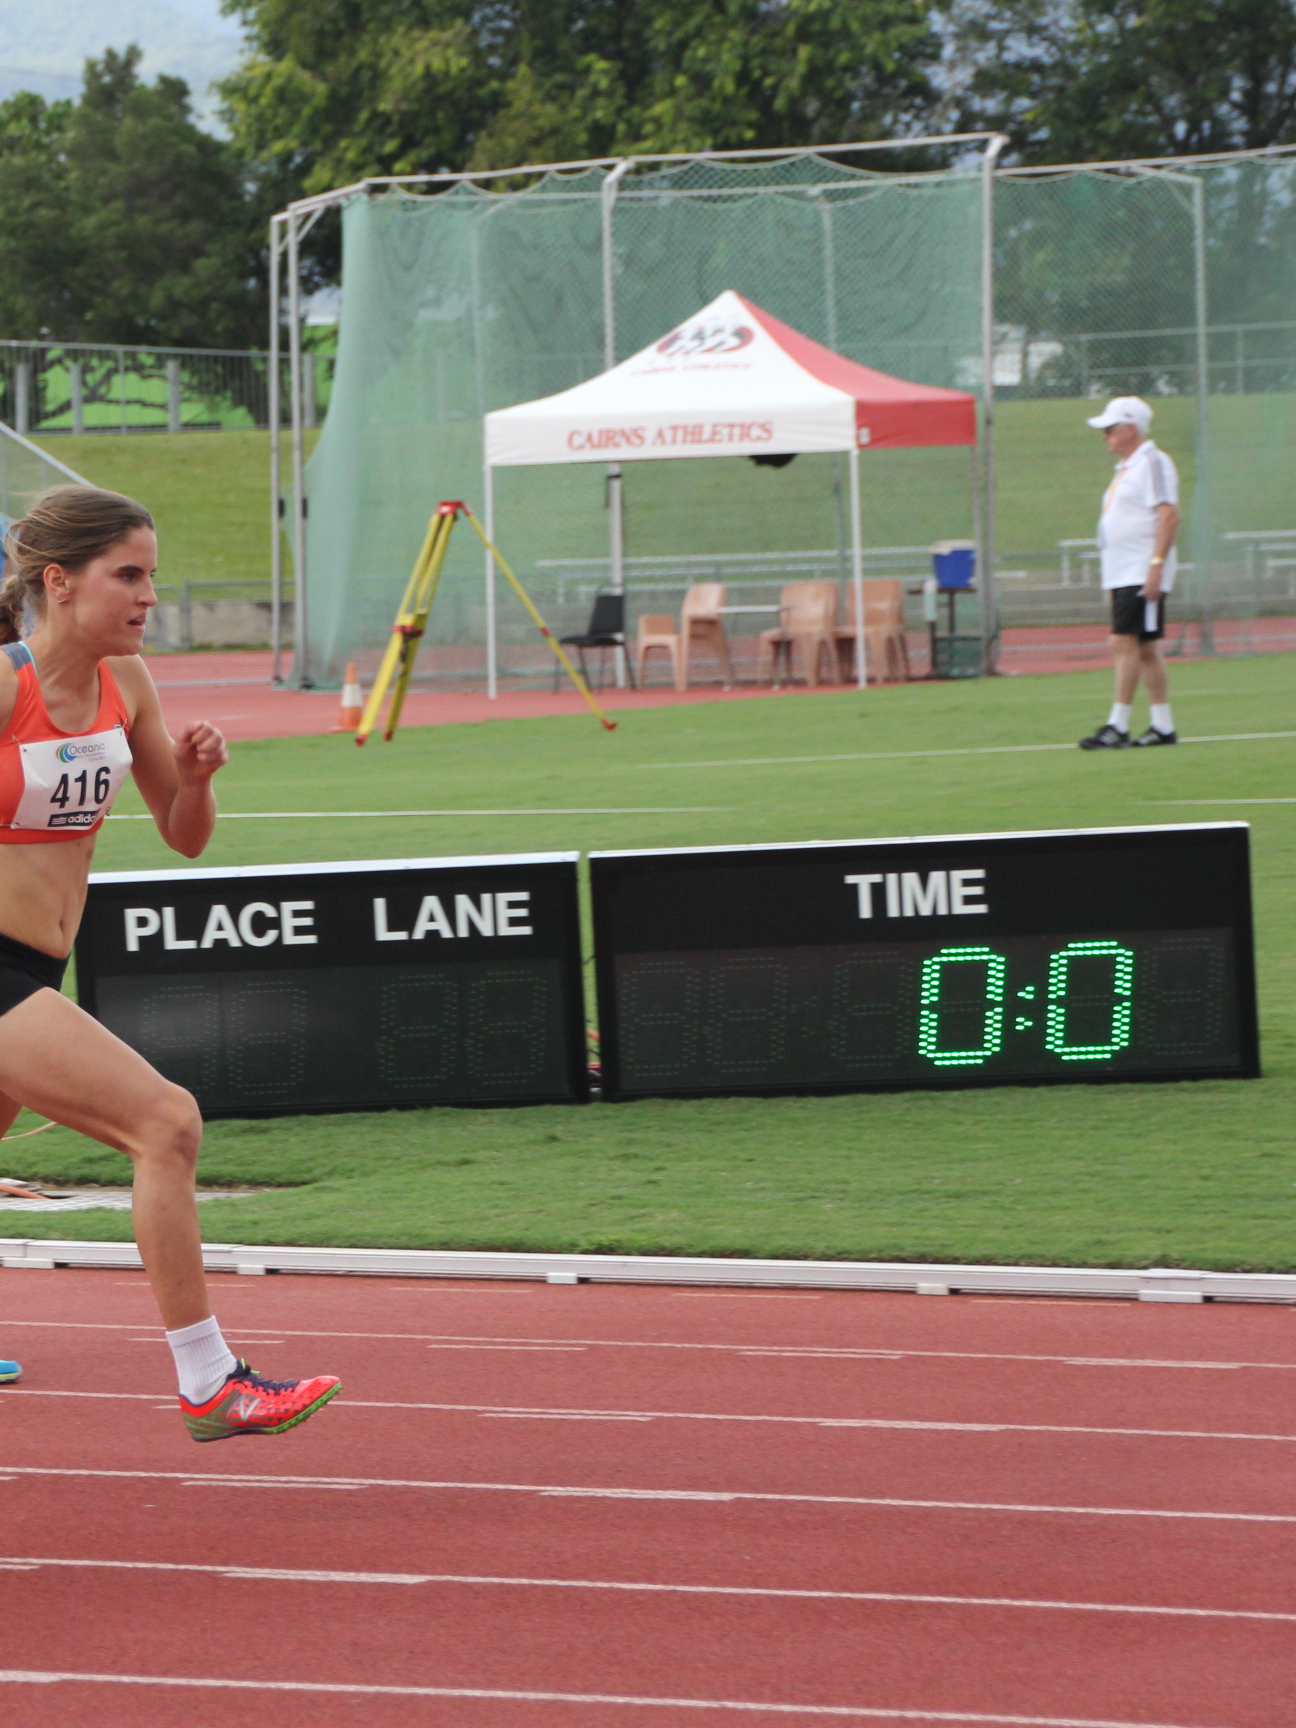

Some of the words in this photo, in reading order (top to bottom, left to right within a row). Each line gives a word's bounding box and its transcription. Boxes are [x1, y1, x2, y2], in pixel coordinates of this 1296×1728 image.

[567, 427, 646, 452] CAIRNS
[650, 420, 775, 448] ATHLETICS
[68, 741, 106, 757] Oceania
[49, 766, 112, 809] 416
[67, 813, 97, 824] adida
[844, 868, 989, 919] TIME
[124, 901, 319, 952] PLACE
[373, 891, 533, 941] LANE
[917, 940, 1134, 1067] 0:0
